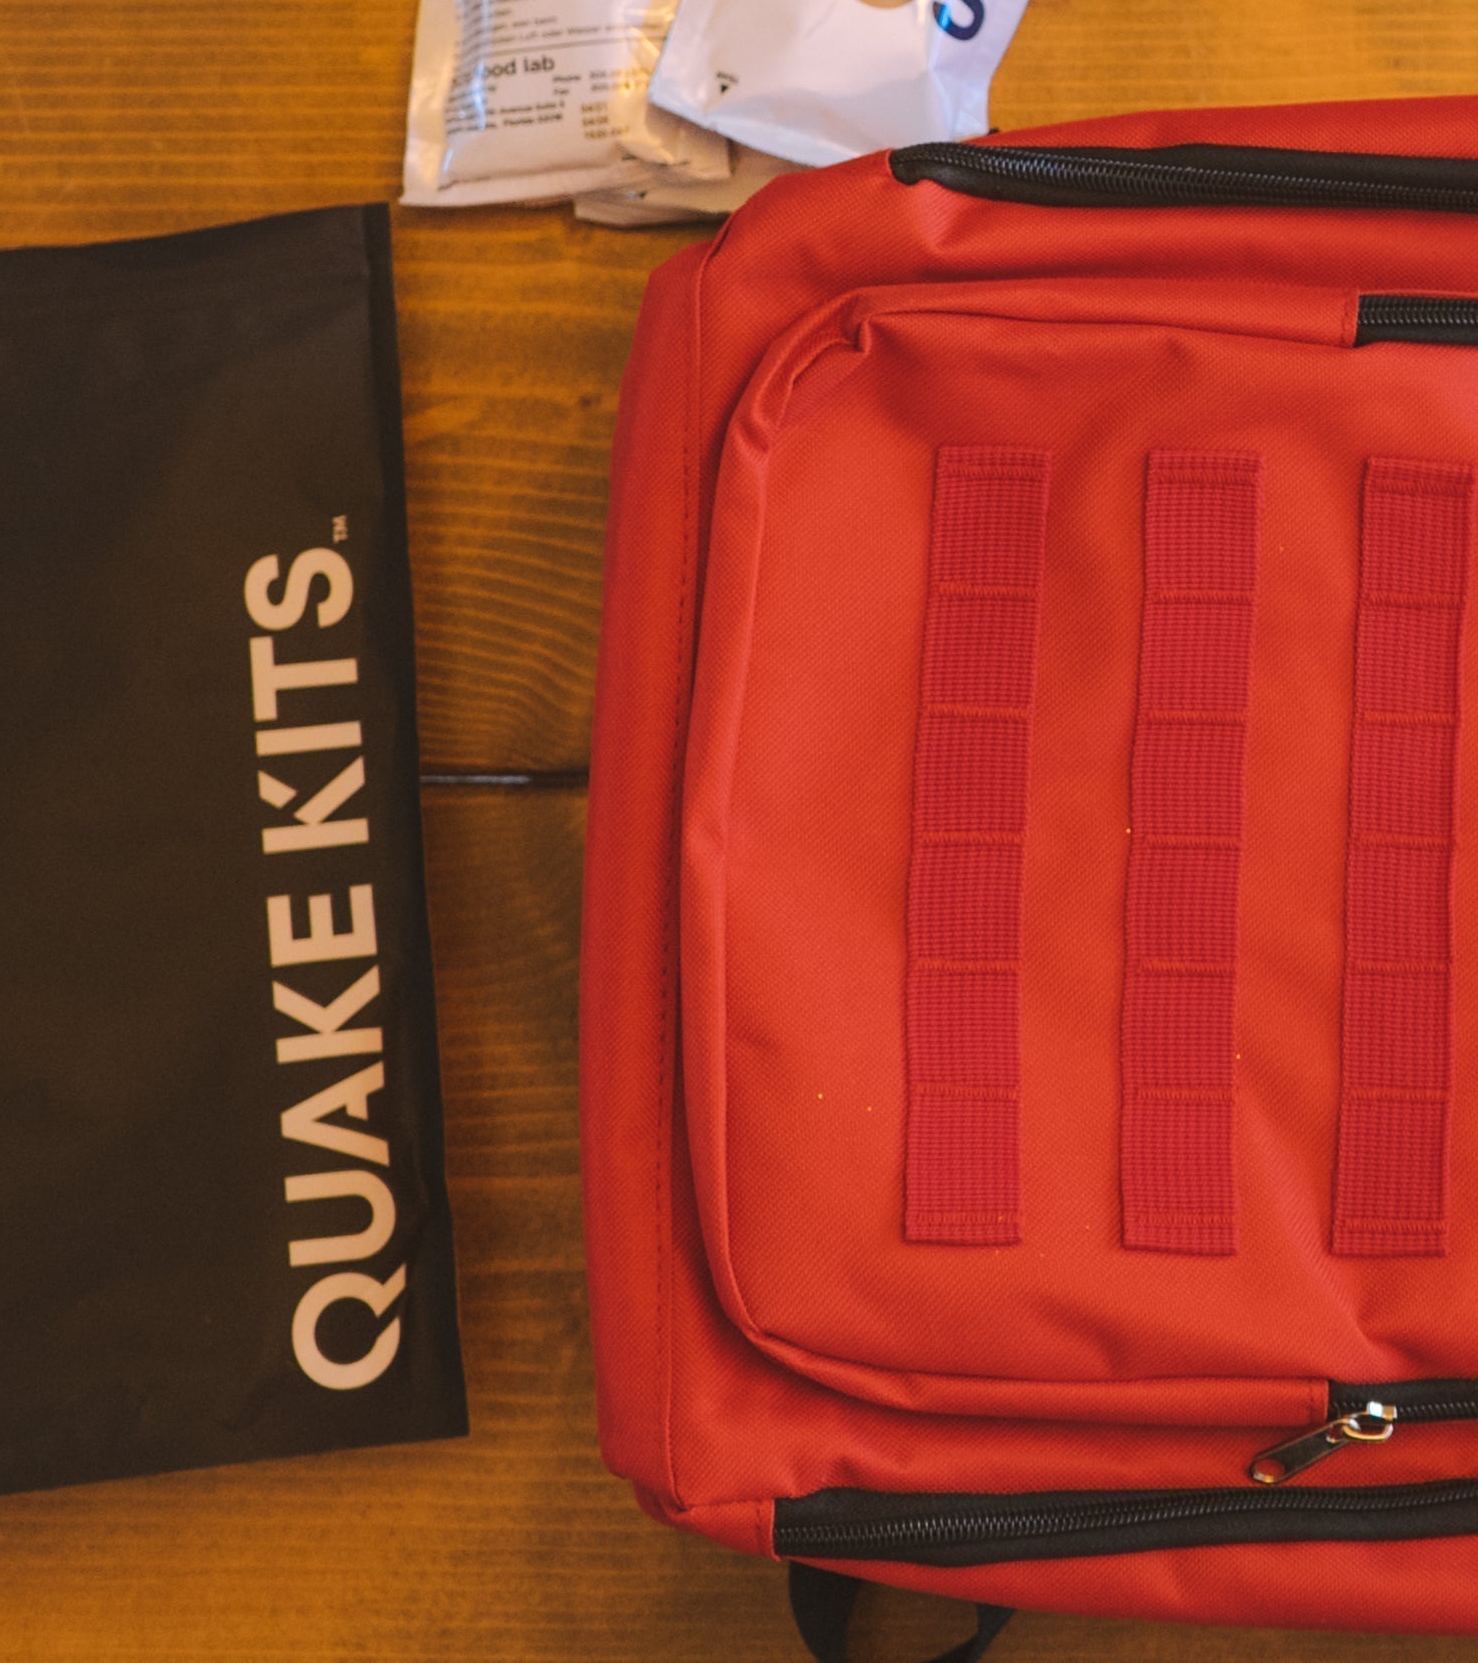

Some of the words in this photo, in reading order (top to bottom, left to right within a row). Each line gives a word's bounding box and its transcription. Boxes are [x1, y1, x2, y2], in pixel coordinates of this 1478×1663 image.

[482, 57, 516, 77] ood
[243, 548, 369, 854] KITS
[266, 883, 407, 1389] QUAKE
